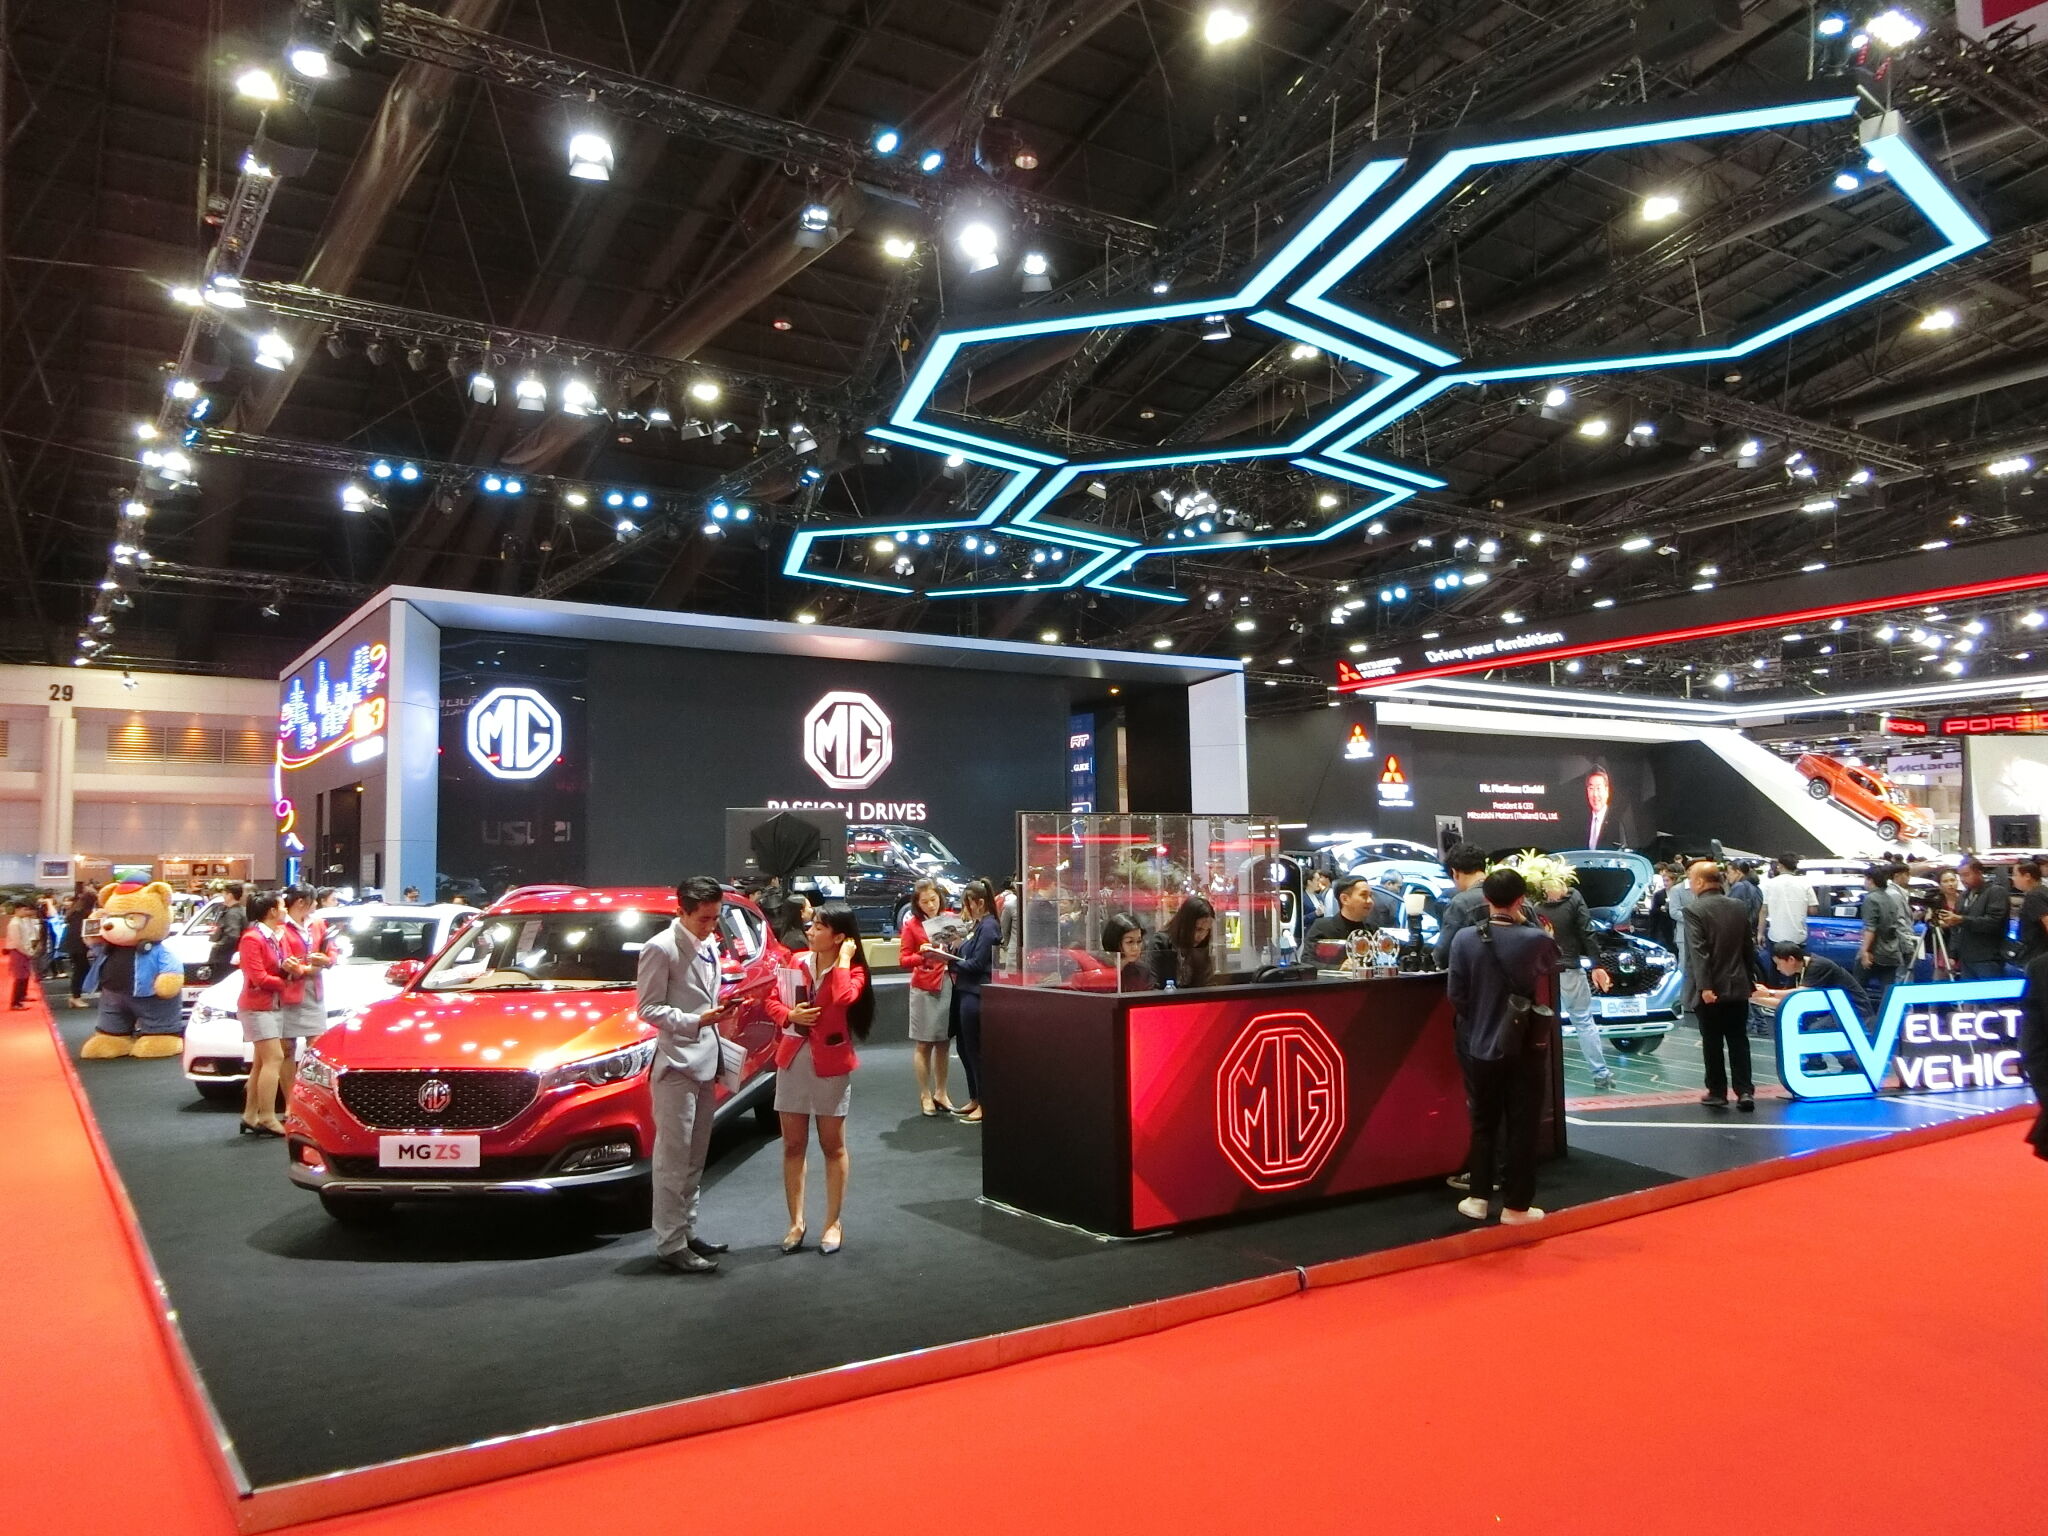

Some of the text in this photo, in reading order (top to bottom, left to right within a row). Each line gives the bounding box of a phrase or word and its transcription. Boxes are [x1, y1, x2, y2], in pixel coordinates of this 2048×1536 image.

[1425, 632, 1564, 663] Drive your Ambition
[50, 684, 73, 701] 29
[478, 698, 551, 769] MG
[815, 703, 882, 778] MG
[860, 803, 926, 821] DRIVES
[1781, 980, 1915, 1097] EV
[1897, 1050, 2027, 1090] VEHIC
[1231, 1032, 1330, 1167] MG
